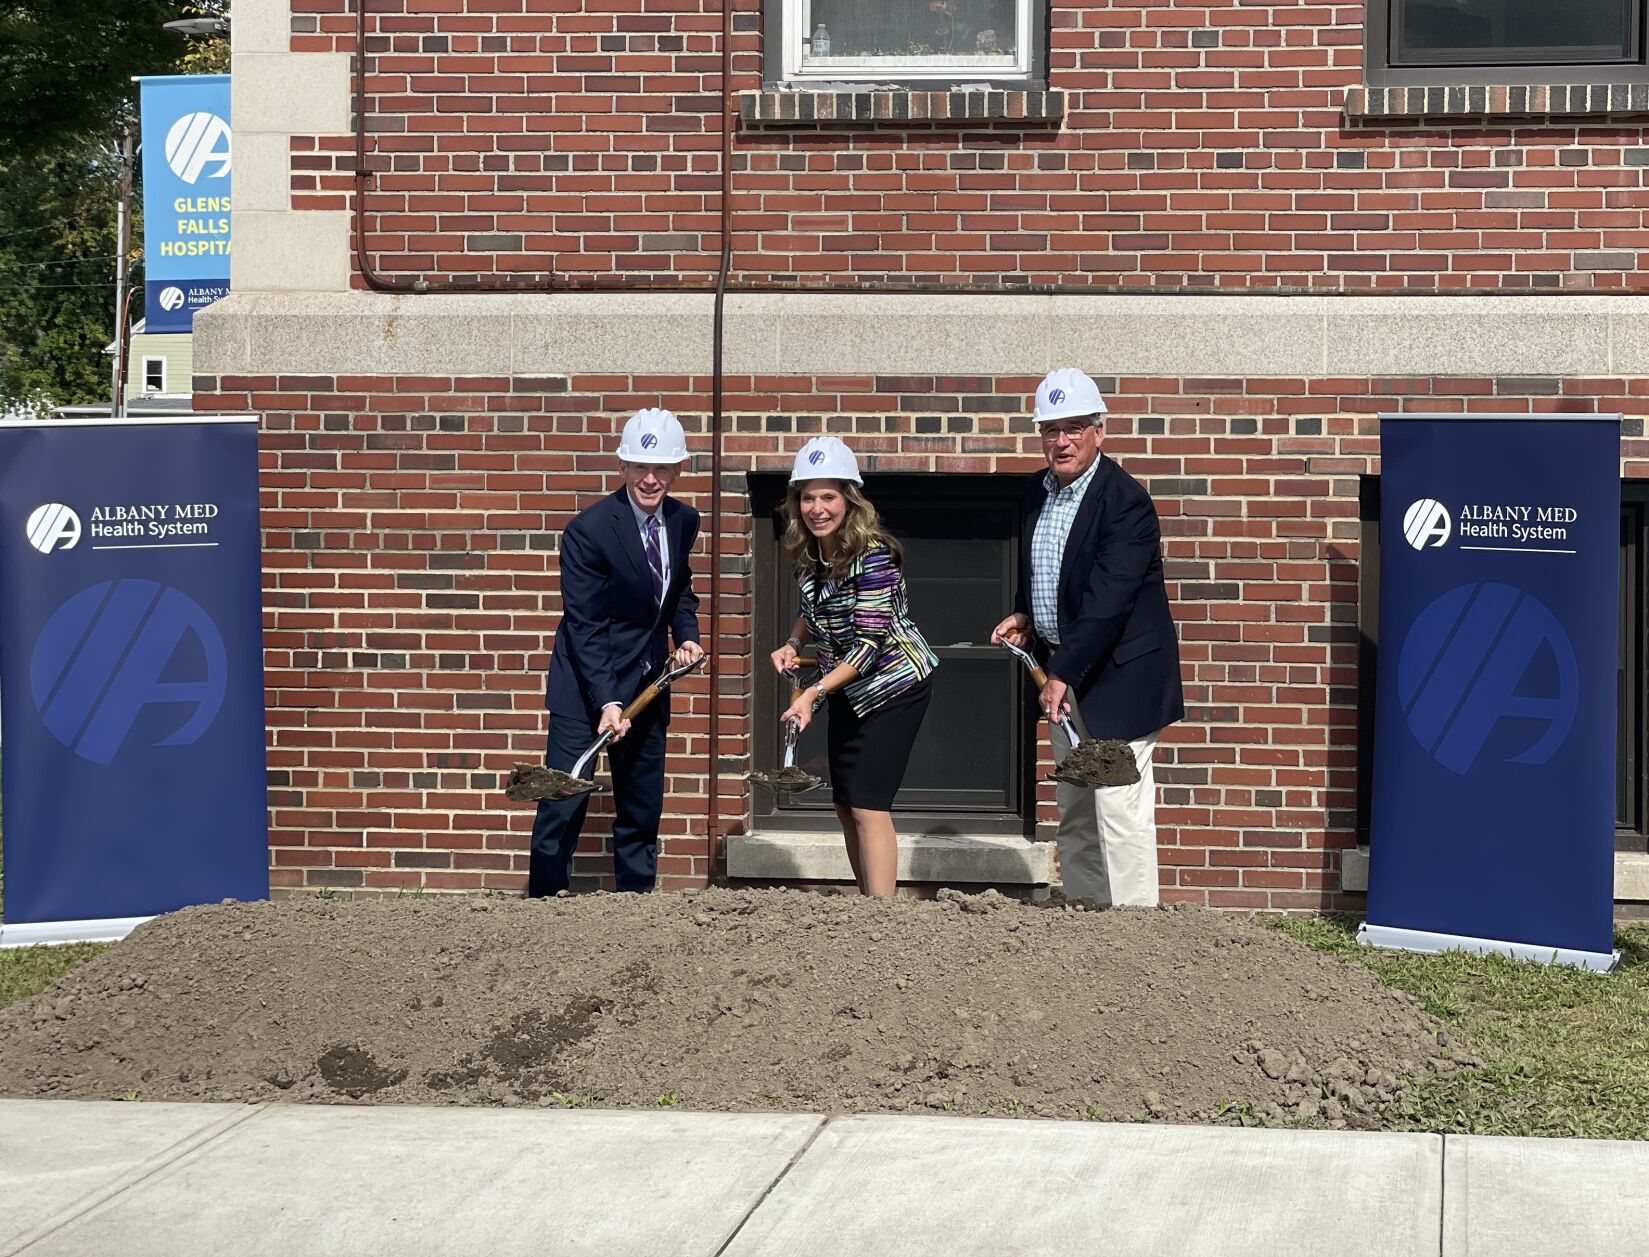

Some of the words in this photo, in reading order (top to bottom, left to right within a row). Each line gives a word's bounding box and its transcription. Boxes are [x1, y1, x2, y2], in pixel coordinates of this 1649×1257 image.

[174, 197, 231, 212] GLENS
[178, 219, 229, 234] FALLS
[188, 288, 223, 296] ALBANY
[91, 505, 169, 520] ALBANY
[174, 503, 218, 518] MED
[1460, 505, 1532, 520] ALBANY
[1536, 507, 1578, 522] MED
[91, 521, 144, 537] Health
[148, 521, 208, 539] System
[1460, 521, 1508, 538] Health
[1512, 523, 1567, 542] System
